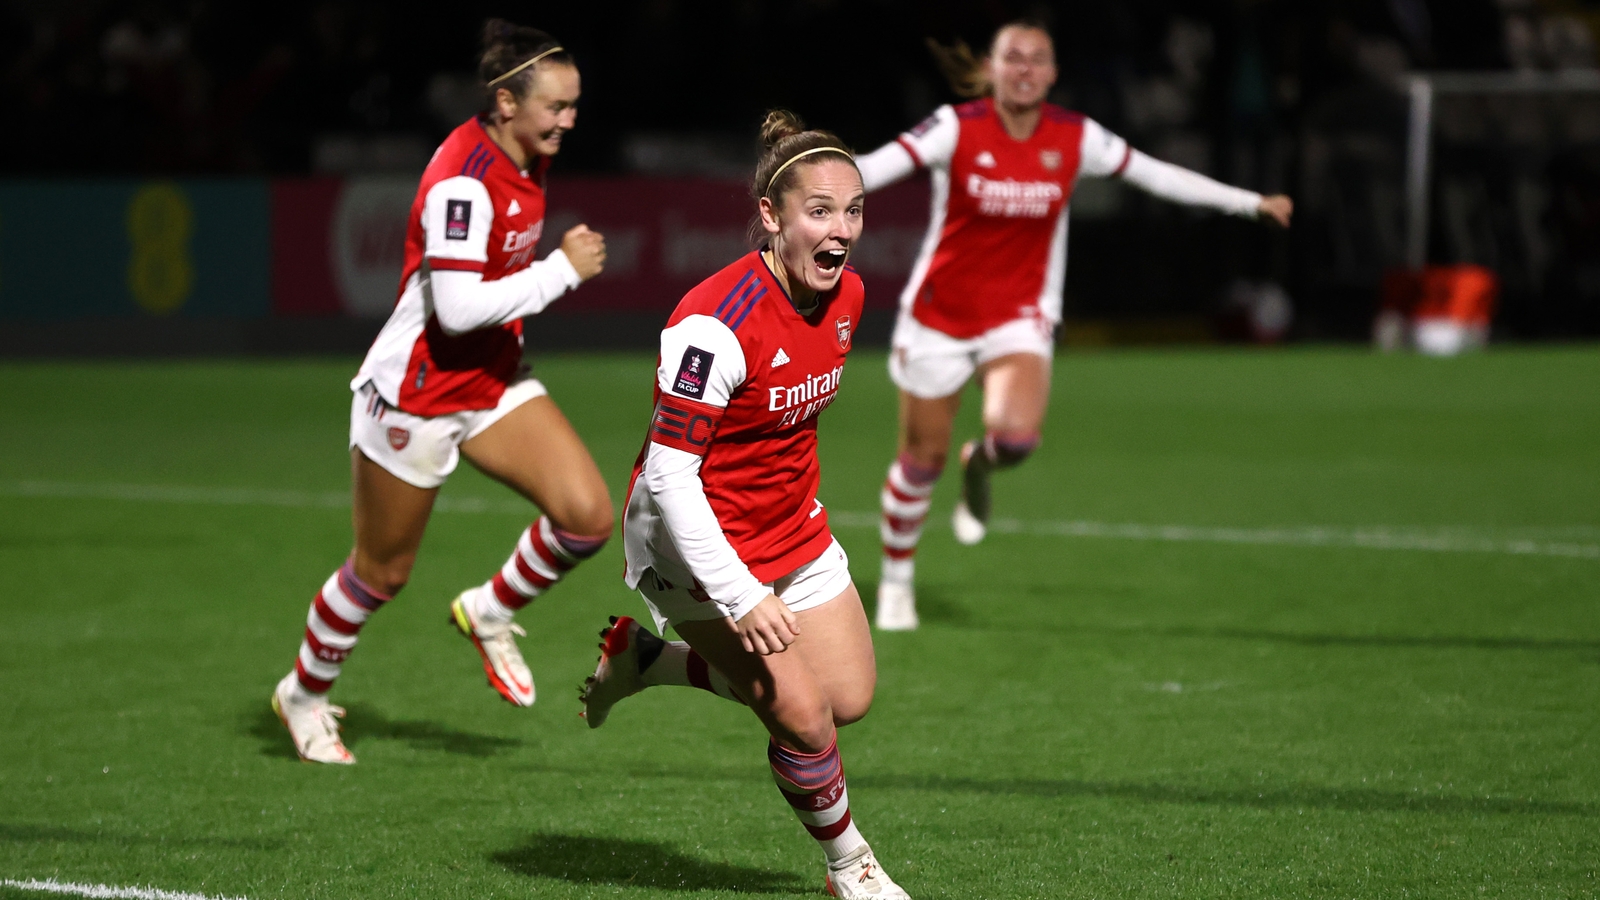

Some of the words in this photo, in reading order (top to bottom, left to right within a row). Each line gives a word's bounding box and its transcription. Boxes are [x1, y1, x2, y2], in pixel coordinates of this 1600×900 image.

[677, 382, 686, 390] FA
[685, 384, 700, 393] CUP
[777, 406, 803, 428] FLY
